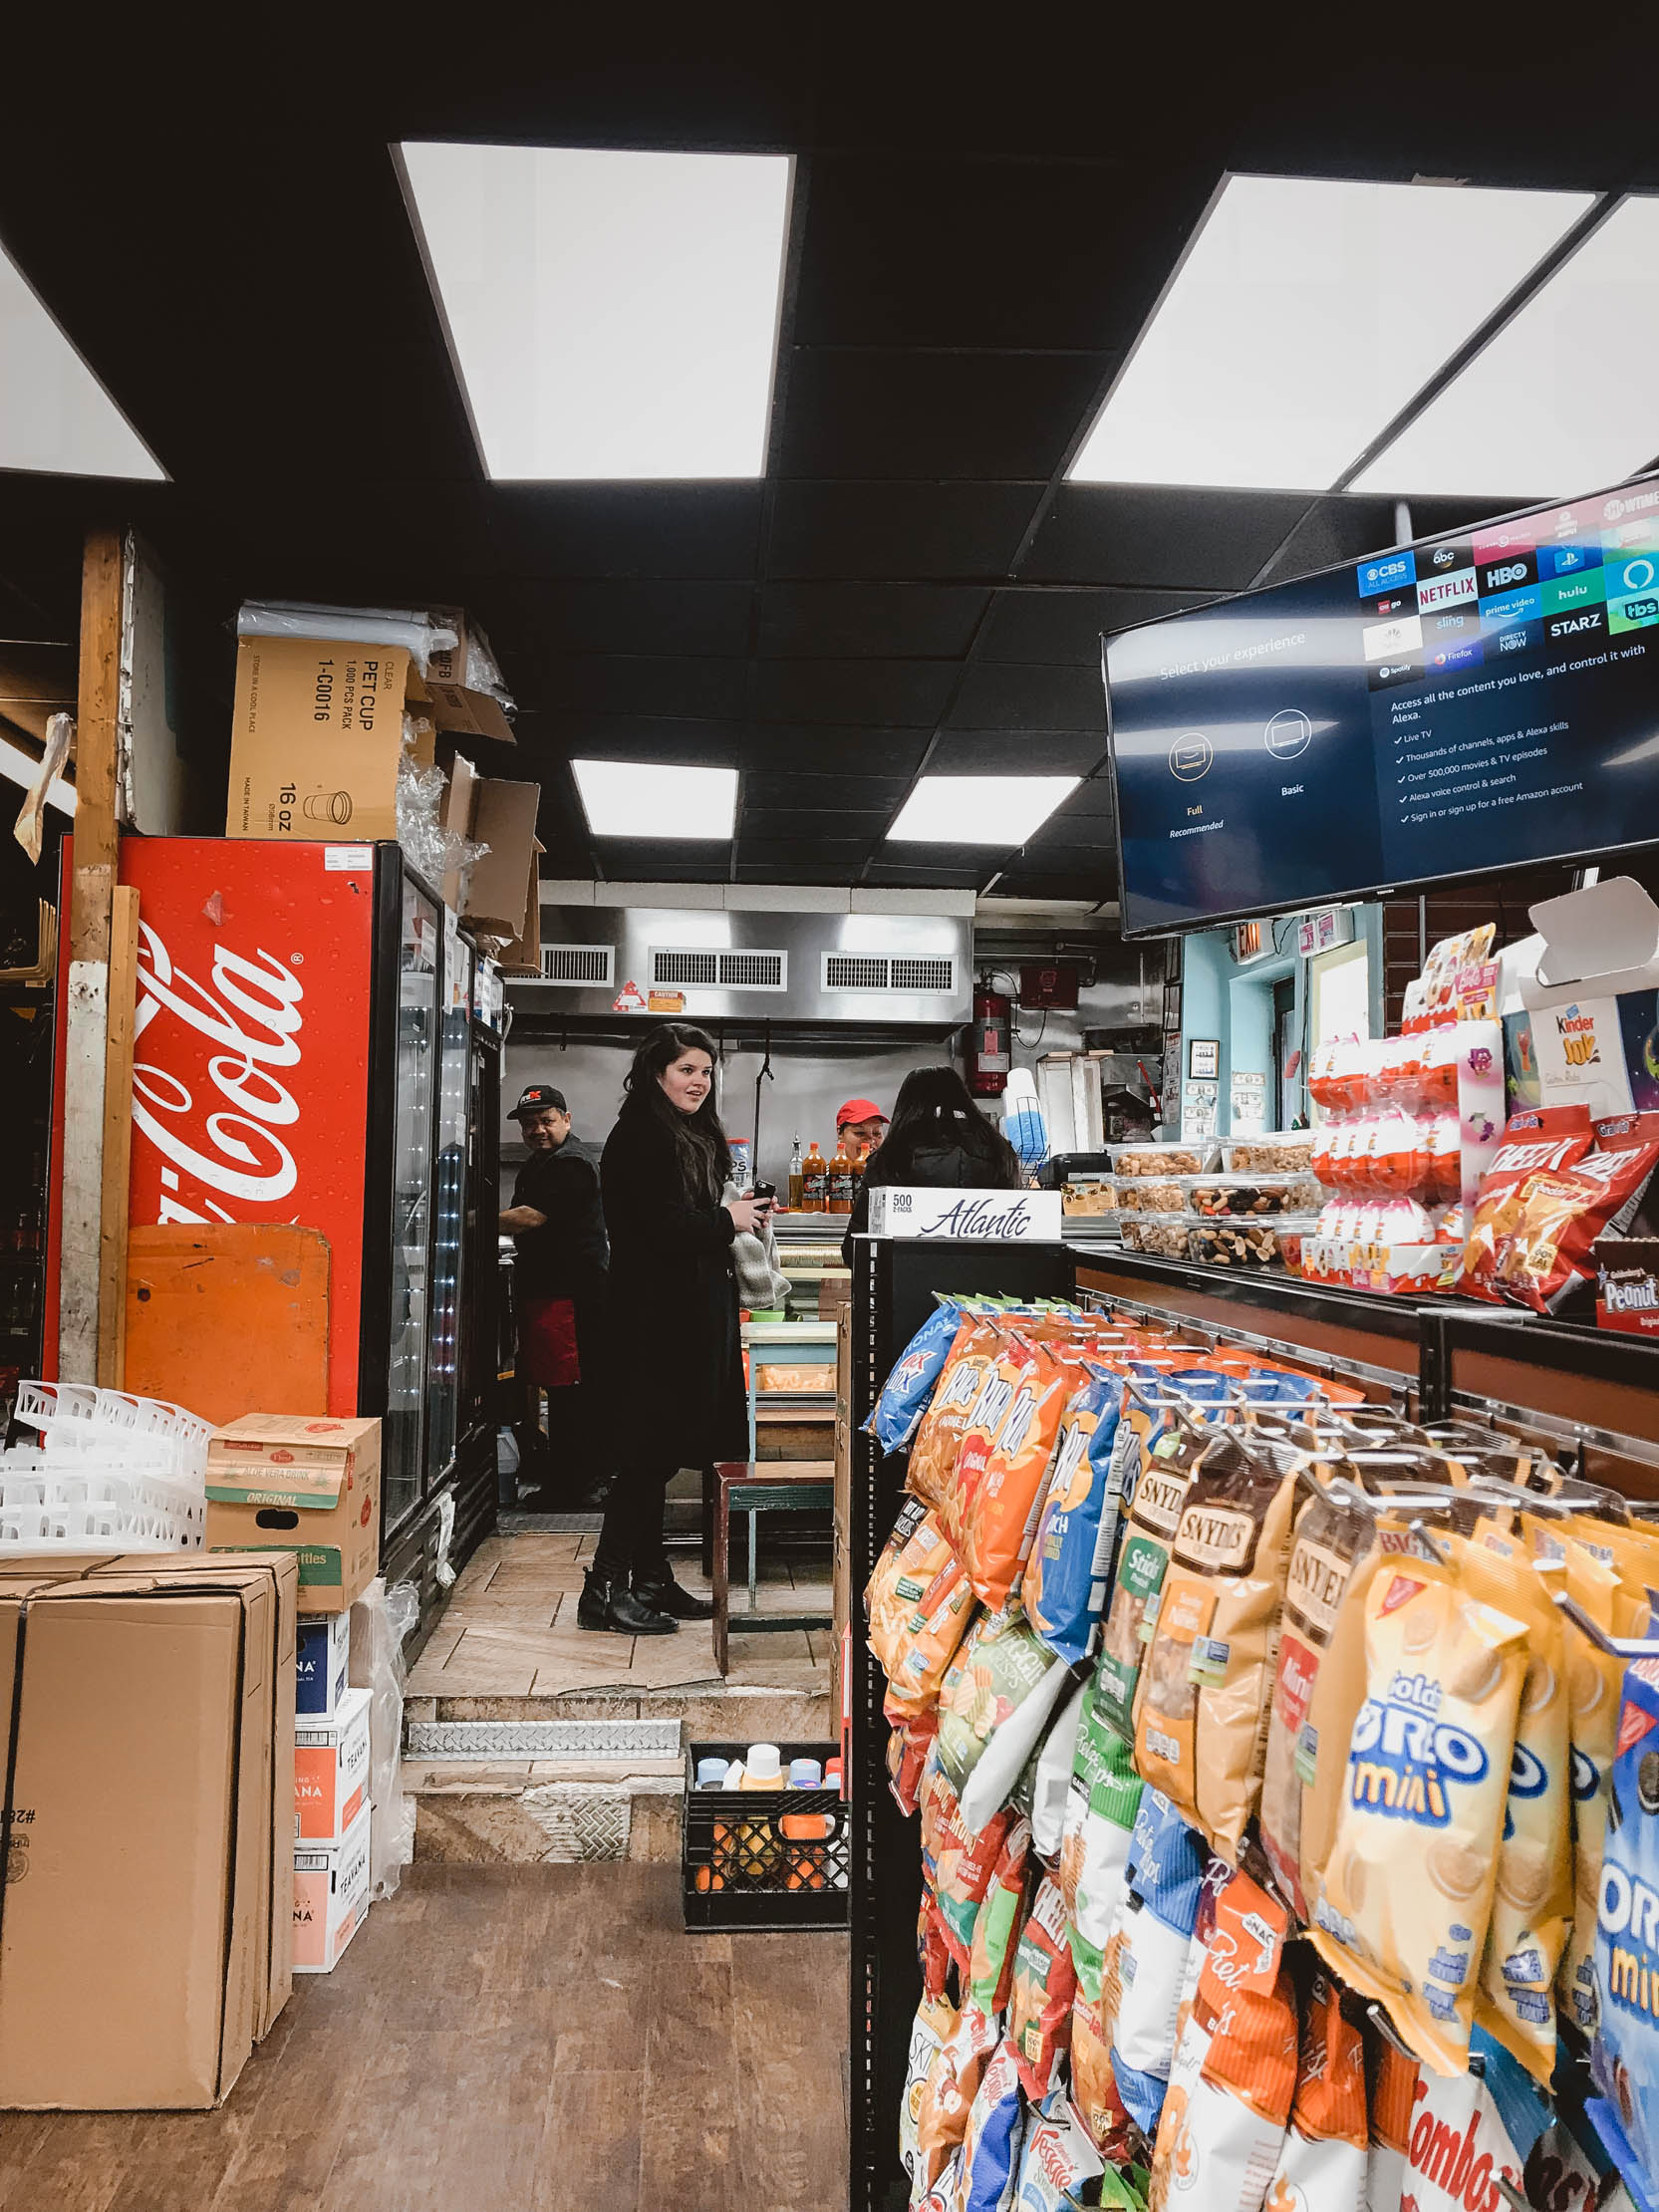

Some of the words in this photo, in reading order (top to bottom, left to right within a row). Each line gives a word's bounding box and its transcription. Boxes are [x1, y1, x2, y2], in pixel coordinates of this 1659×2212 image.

[1433, 551, 1455, 564] abc
[1379, 561, 1406, 577] CBS
[1487, 563, 1527, 588] HBO
[1420, 577, 1475, 606] NETFLIX
[1558, 586, 1587, 600] hulu
[1486, 603, 1511, 618] prime
[1512, 597, 1535, 609] video
[1628, 602, 1658, 619] tbs
[1436, 615, 1464, 630] sling
[1550, 614, 1601, 637] STARZ
[1448, 649, 1473, 661] Firefox
[1500, 638, 1527, 652] NOW
[252, 655, 261, 677] STORE
[1161, 663, 1202, 681] Select
[1202, 653, 1230, 673] your
[1234, 633, 1305, 661] experience
[251, 677, 259, 686] IN
[345, 660, 357, 684] 1,000
[362, 661, 379, 692] PET
[383, 661, 394, 691] CLEAR
[1391, 697, 1422, 711] Access
[1424, 693, 1436, 705] all
[1438, 690, 1455, 701] the
[1457, 680, 1496, 696] content
[1498, 677, 1517, 691] you
[1519, 670, 1544, 683] love,
[1546, 663, 1566, 677] and
[1569, 654, 1608, 672] control
[1610, 651, 1619, 662] it
[1621, 645, 1646, 659] with
[314, 659, 334, 721] 1-C0016
[344, 686, 355, 703] PCS
[249, 692, 258, 711] COOL
[342, 705, 353, 730] PACK
[359, 695, 375, 731] CUP
[1392, 710, 1421, 724] Alexa.
[1404, 732, 1420, 743] Live
[1420, 729, 1432, 739] TV
[1406, 746, 1447, 763] Thousands
[1448, 743, 1458, 754] of
[1458, 737, 1495, 751] channels,
[1497, 732, 1516, 745] apps
[1517, 730, 1524, 739] &
[1525, 725, 1548, 737] Alexa
[1549, 720, 1569, 733] skills
[1407, 772, 1427, 783] Over
[1428, 765, 1460, 779] 500,000
[1461, 758, 1490, 771] movies
[1490, 756, 1498, 766] &
[1499, 753, 1511, 763] TV
[1512, 746, 1547, 762] episodes
[279, 782, 296, 805] 16
[1281, 783, 1304, 797] Basic
[1409, 789, 1431, 803] Alexa
[1431, 786, 1452, 799] voice
[1452, 781, 1481, 795] control
[1481, 779, 1489, 789] &
[1490, 773, 1517, 787] search
[1187, 804, 1203, 816] Full
[1411, 810, 1429, 824] Sign
[1429, 808, 1437, 819] in
[1438, 808, 1447, 817] or
[1448, 802, 1465, 816] sign
[1466, 801, 1477, 813] up
[1477, 797, 1490, 810] for
[1498, 793, 1515, 806] free
[1516, 787, 1549, 802] Amazon
[1550, 781, 1583, 797] account
[278, 810, 293, 832] oz
[1170, 819, 1225, 839] Recommended
[1556, 1015, 1594, 1034] Kinder
[893, 1194, 913, 1207] 500
[921, 1198, 1031, 1238] Atlantic
[1603, 1274, 1659, 1313] Peanut
[285, 1469, 311, 1481] DRINK
[246, 1492, 298, 1507] ORIGINAL
[1597, 1862, 1659, 1949] OR
